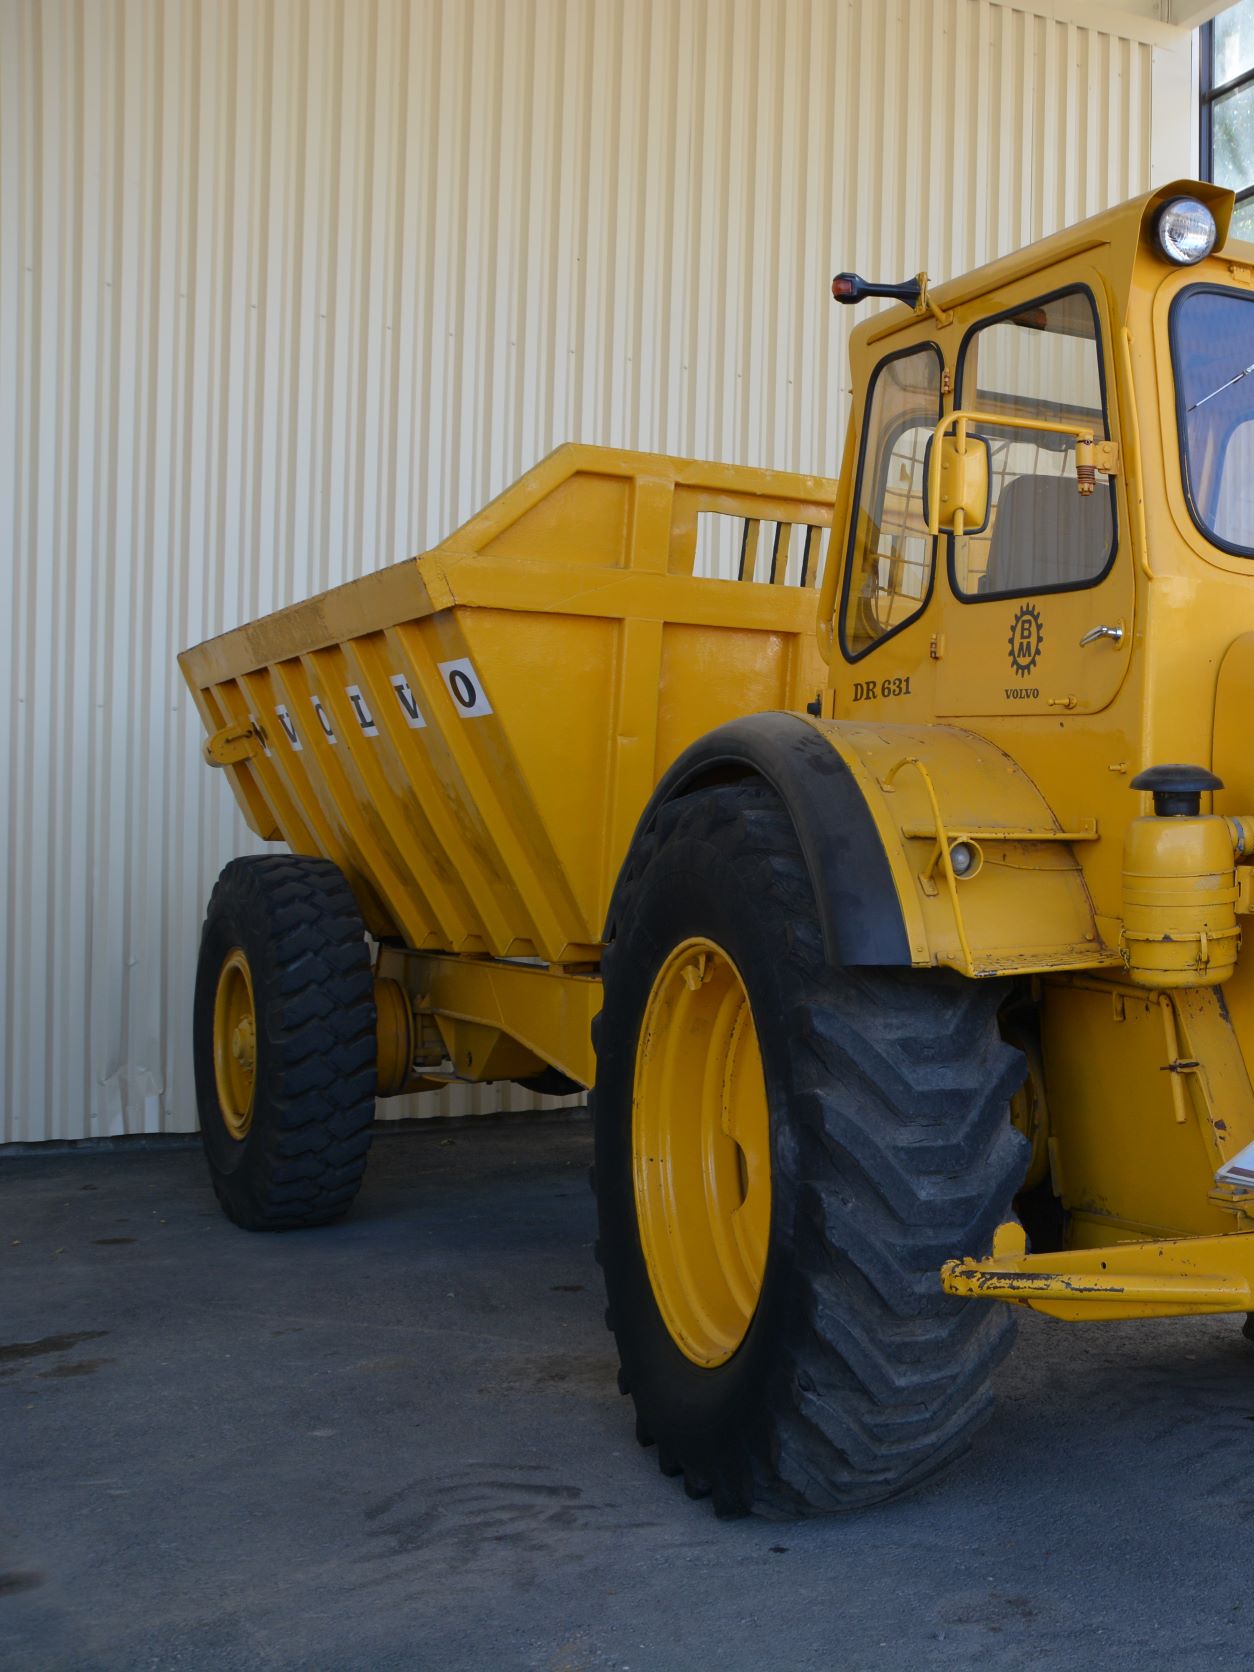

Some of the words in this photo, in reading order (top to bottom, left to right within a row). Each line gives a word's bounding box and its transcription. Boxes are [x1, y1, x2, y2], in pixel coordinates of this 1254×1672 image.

[853, 681, 877, 702] DR
[881, 676, 912, 698] 631
[1004, 688, 1040, 700] VOLVO
